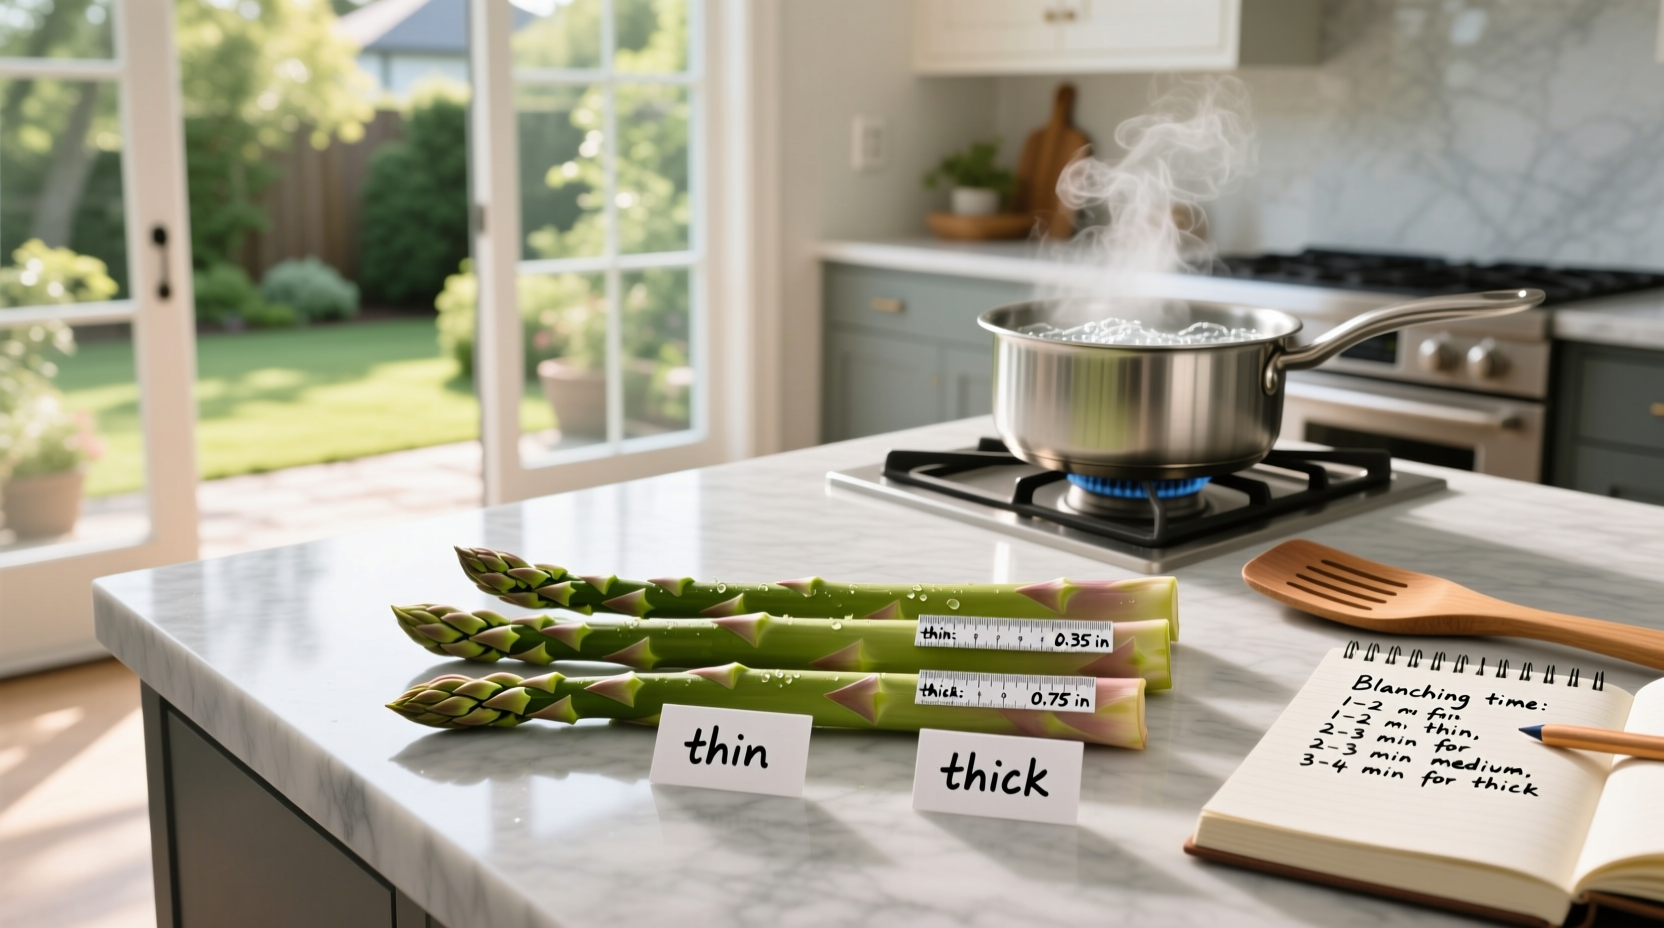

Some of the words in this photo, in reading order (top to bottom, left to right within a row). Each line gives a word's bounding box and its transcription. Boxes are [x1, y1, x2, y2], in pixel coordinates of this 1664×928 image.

[920, 626, 957, 640] thin:
[1054, 633, 1092, 648] 0.35
[1095, 635, 1109, 648] in
[1031, 692, 1071, 707] 0.75
[1075, 694, 1090, 708] in
[1342, 696, 1383, 712] 1-2
[1351, 674, 1470, 710] Blanching
[1485, 693, 1548, 711] time:
[1331, 709, 1371, 725] 1-2
[684, 725, 769, 769] thin
[1309, 738, 1358, 756] 2-3
[1369, 749, 1411, 763] min
[1319, 722, 1365, 739] 2-3
[1376, 733, 1417, 747] min
[1434, 738, 1471, 753] for
[940, 751, 1049, 798] thick
[1299, 753, 1348, 773] 3-4
[1361, 765, 1404, 779] min
[1421, 770, 1457, 787] for
[1471, 776, 1539, 797] thick
